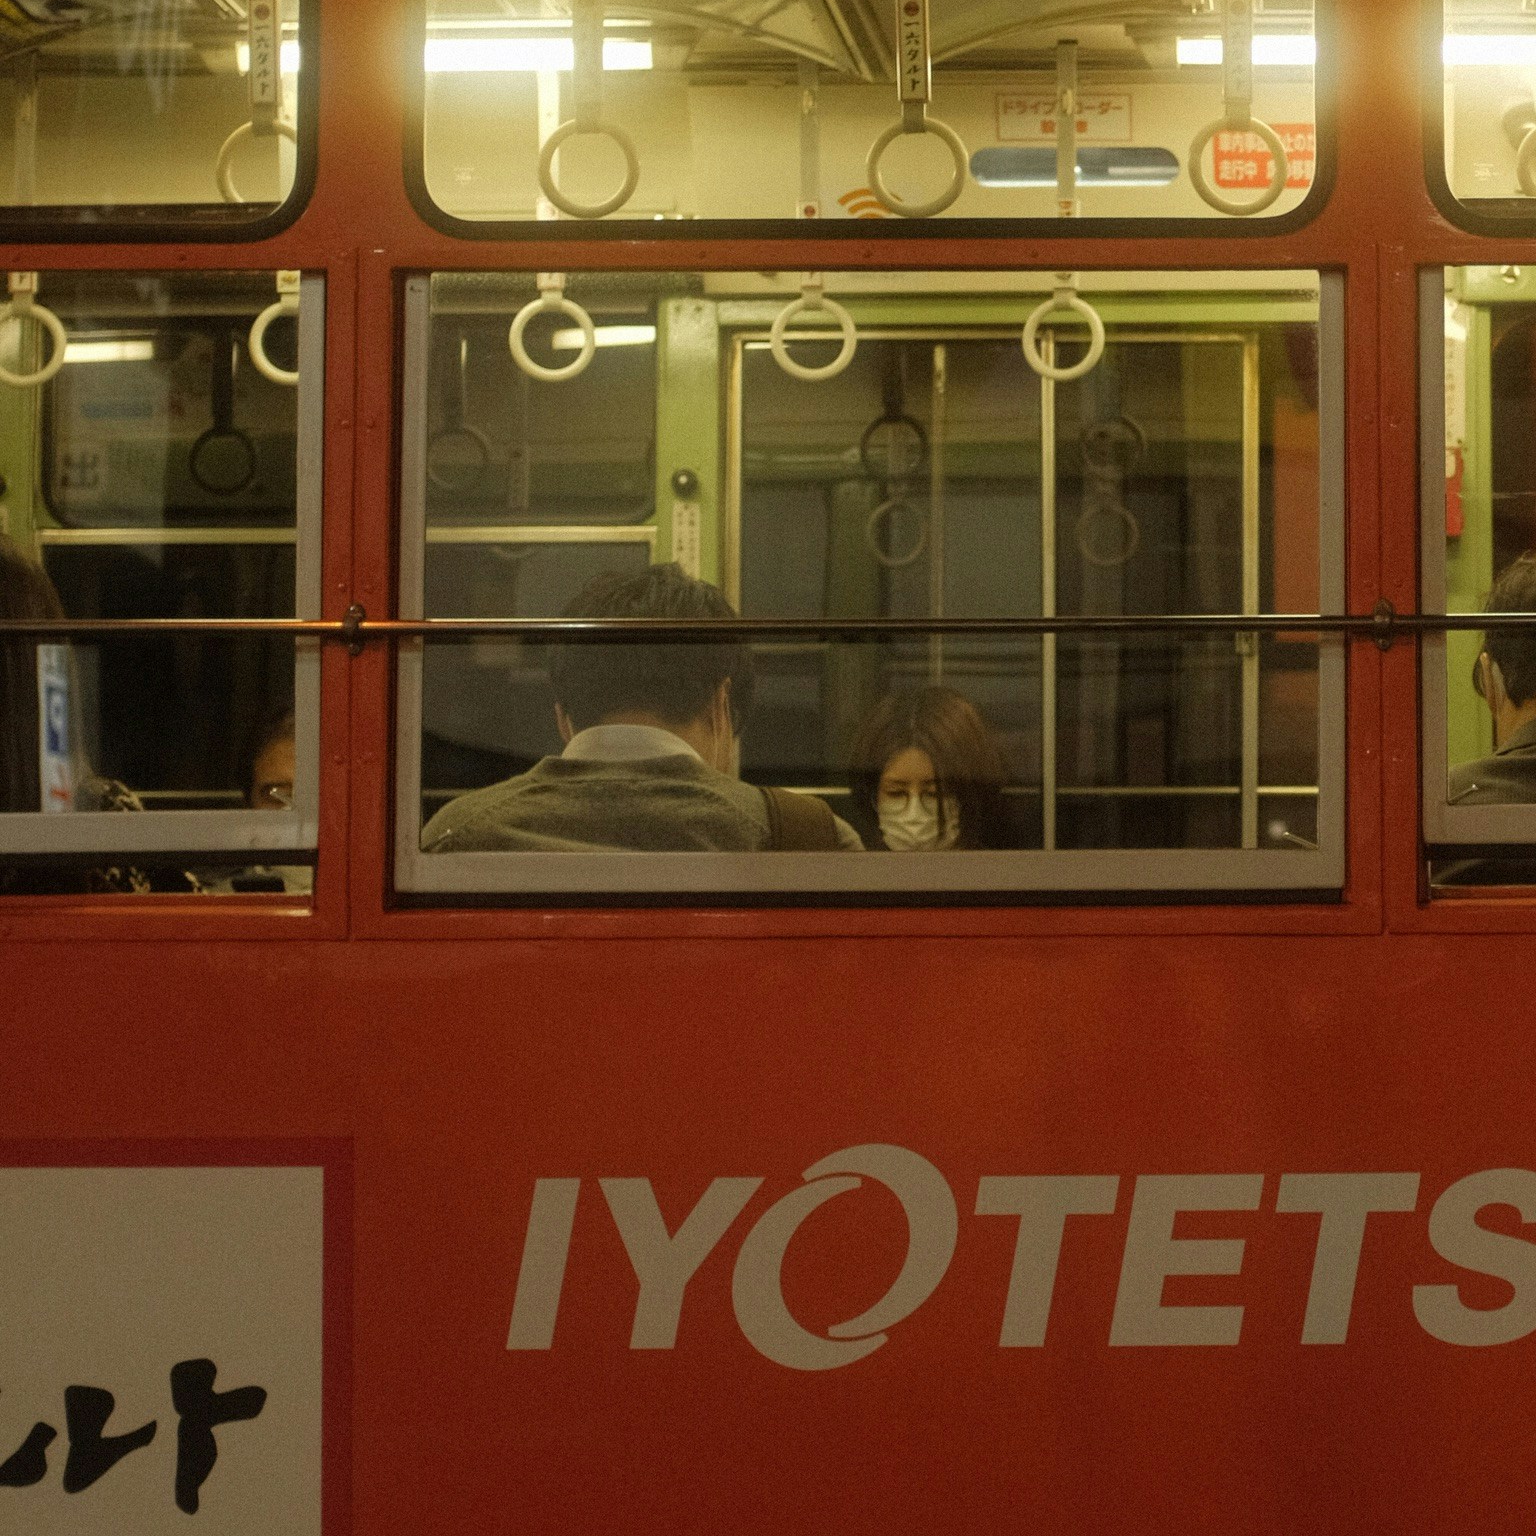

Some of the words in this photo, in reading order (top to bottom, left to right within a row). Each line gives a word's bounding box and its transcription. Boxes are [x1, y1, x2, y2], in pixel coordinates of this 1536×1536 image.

[253, 23, 271, 96] 一六タルト
[903, 19, 922, 93] 一六タルト
